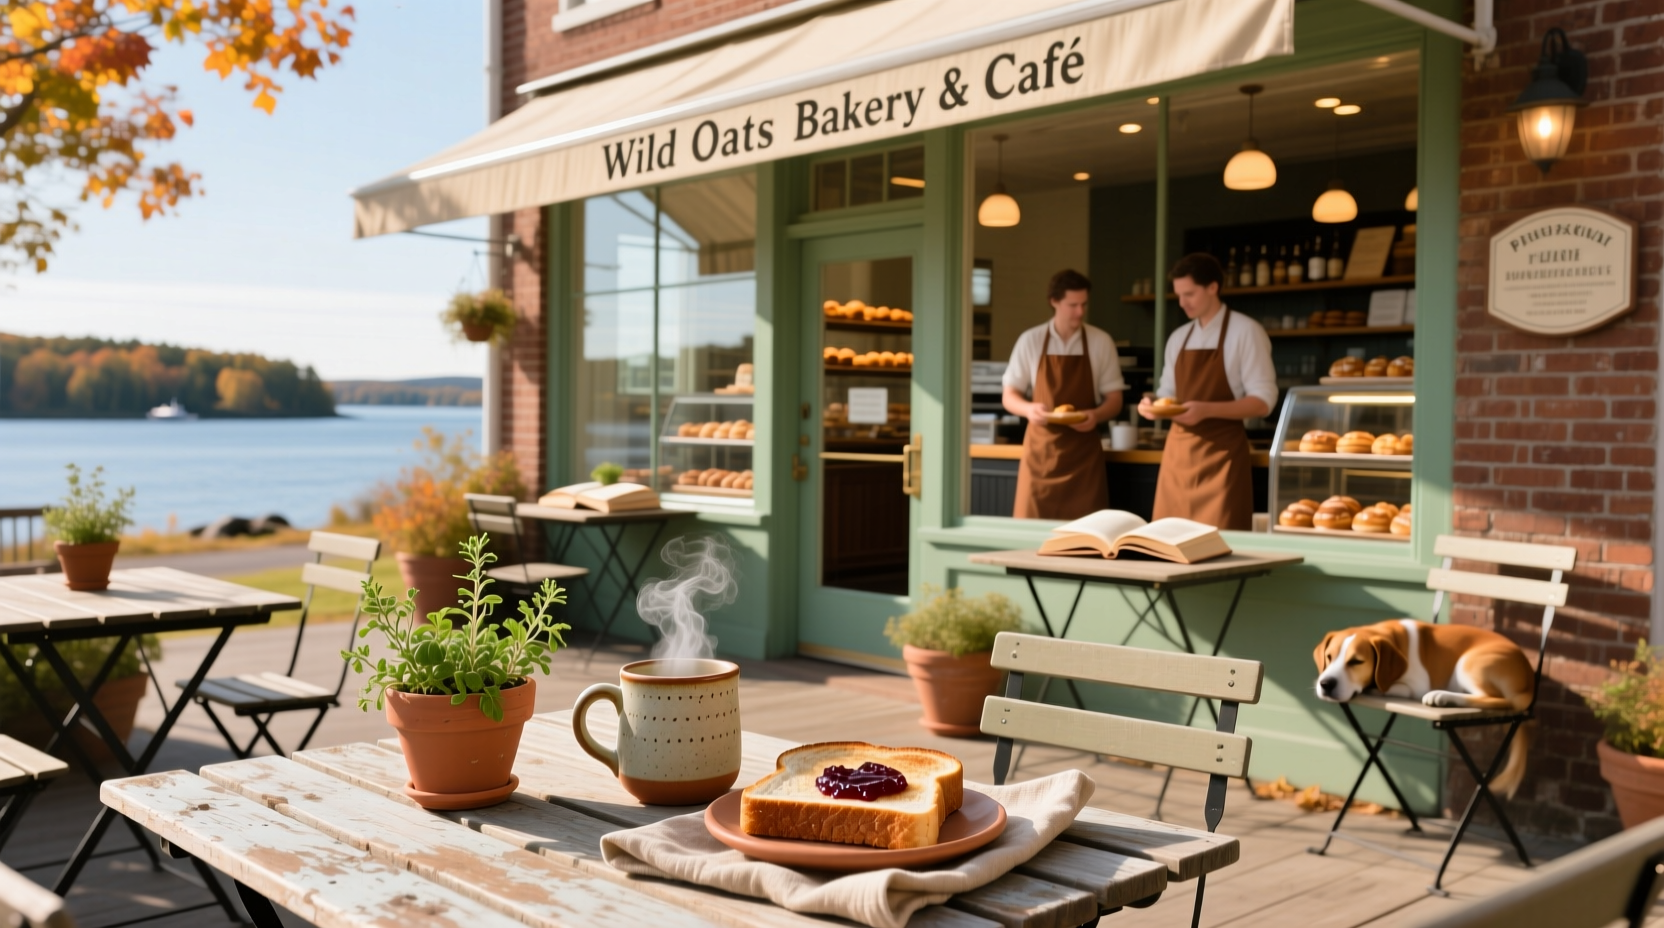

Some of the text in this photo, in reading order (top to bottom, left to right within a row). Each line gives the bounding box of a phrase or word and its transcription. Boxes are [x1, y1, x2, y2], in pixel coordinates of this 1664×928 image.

[602, 37, 1085, 181] Wild Oats Bakery & Café
